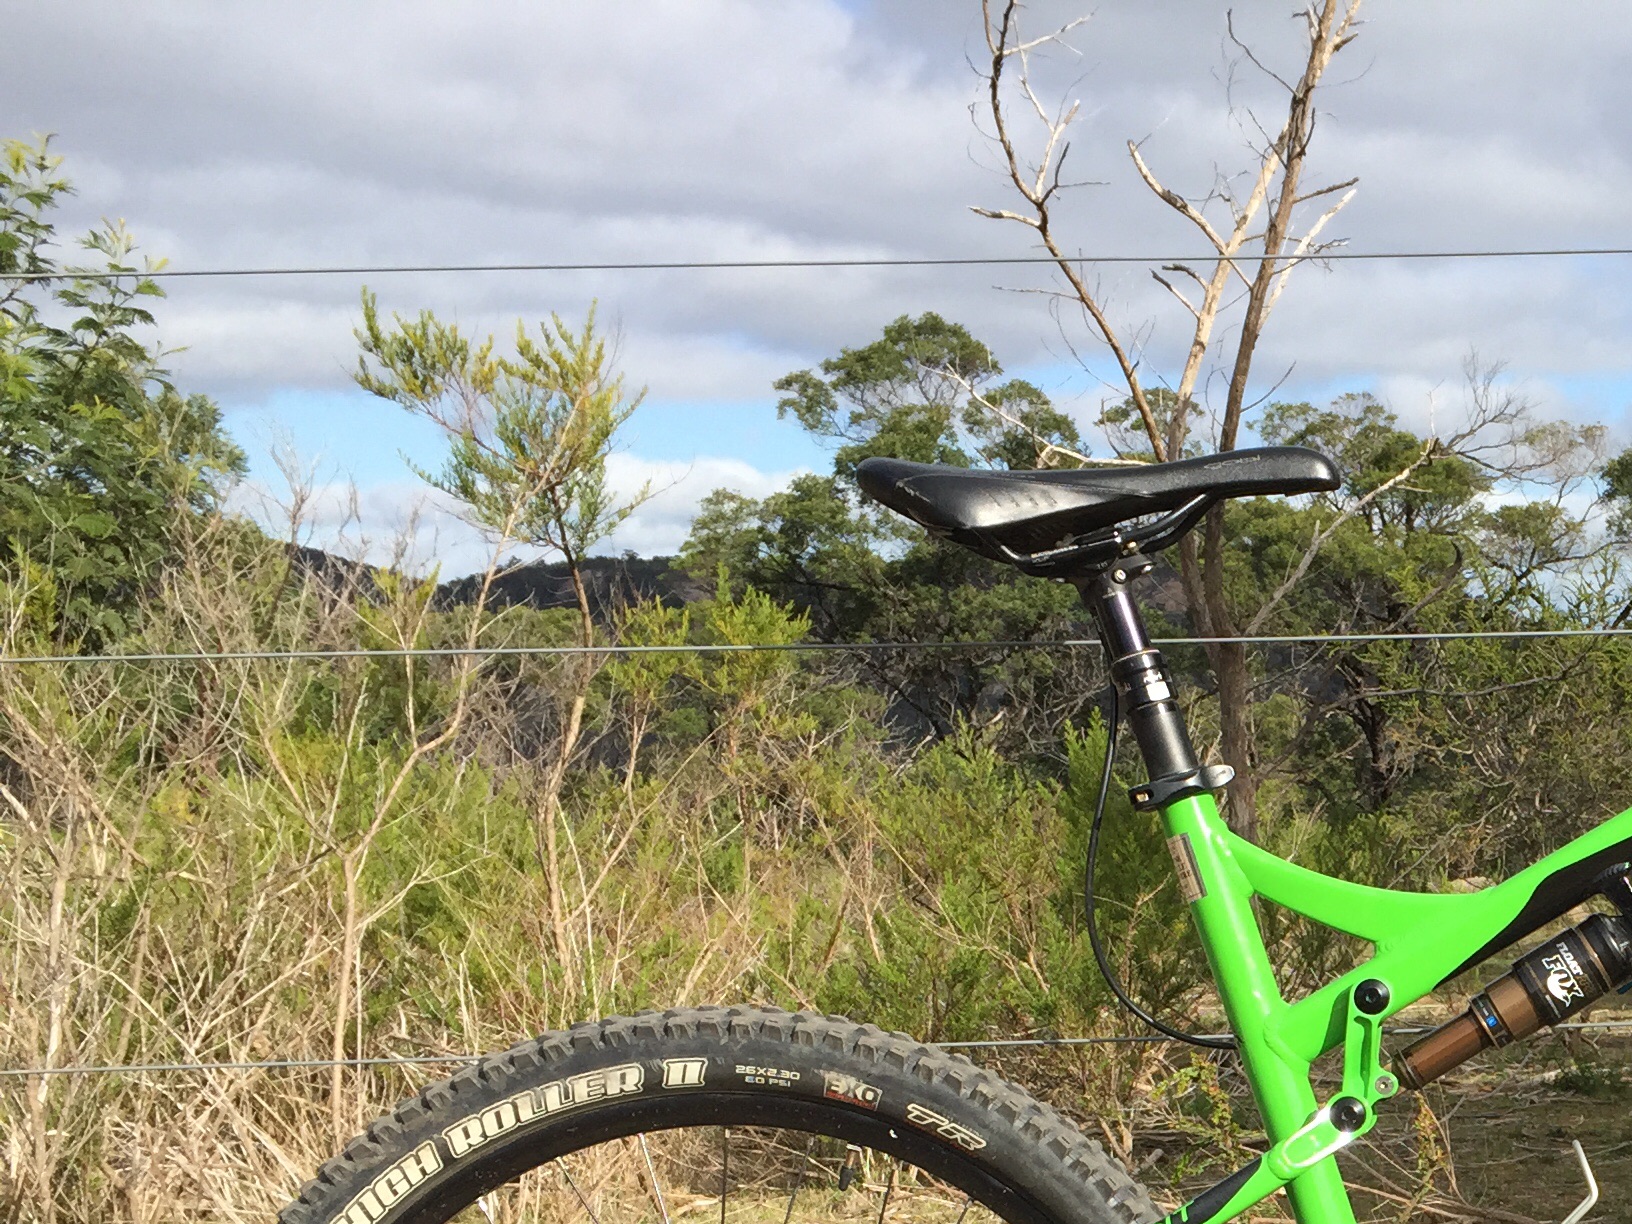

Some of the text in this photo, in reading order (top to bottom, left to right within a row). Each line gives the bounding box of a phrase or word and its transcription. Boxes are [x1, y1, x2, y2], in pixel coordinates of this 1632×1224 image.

[1556, 942, 1584, 976] FLOAT
[1541, 954, 1585, 1002] FOX
[735, 1064, 801, 1081] 26X2.30
[744, 1076, 792, 1088] 60 PSI
[825, 1074, 882, 1104] EXO
[442, 1062, 645, 1159] ROLLER
[906, 1102, 987, 1151] TR
